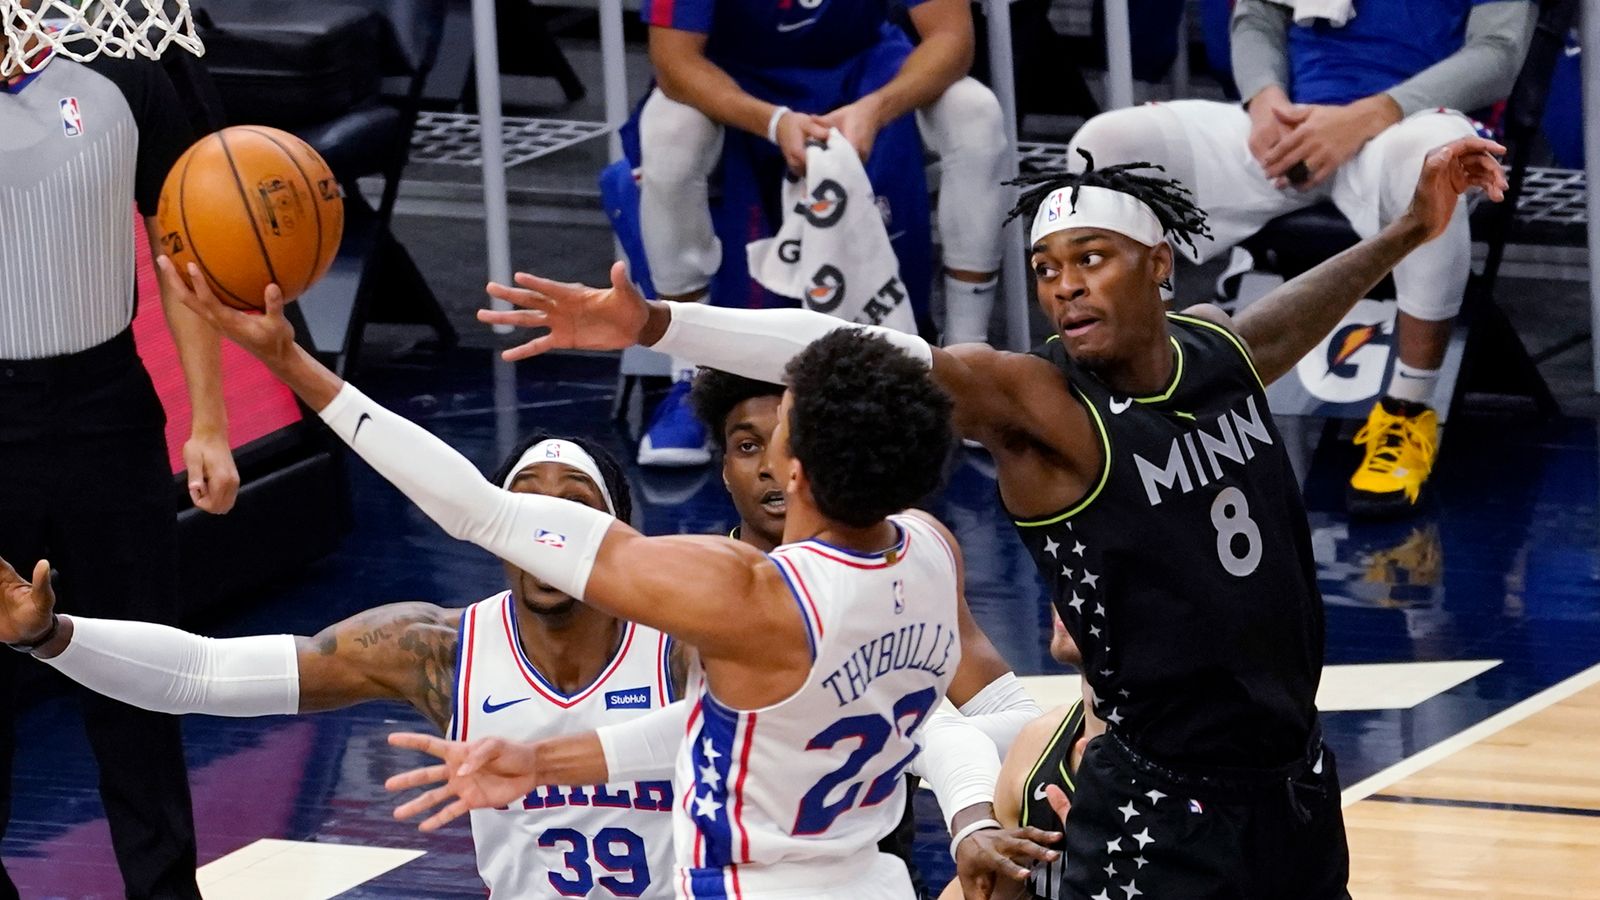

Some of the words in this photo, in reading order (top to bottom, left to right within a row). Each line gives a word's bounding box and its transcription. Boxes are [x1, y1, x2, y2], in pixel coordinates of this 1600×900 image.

[856, 277, 905, 326] AT
[1133, 394, 1273, 506] MINN
[1210, 486, 1263, 577] 8
[611, 694, 647, 705] StubHub
[822, 623, 955, 708] THYBULLE
[791, 686, 937, 836] 22
[538, 827, 651, 898] 39
